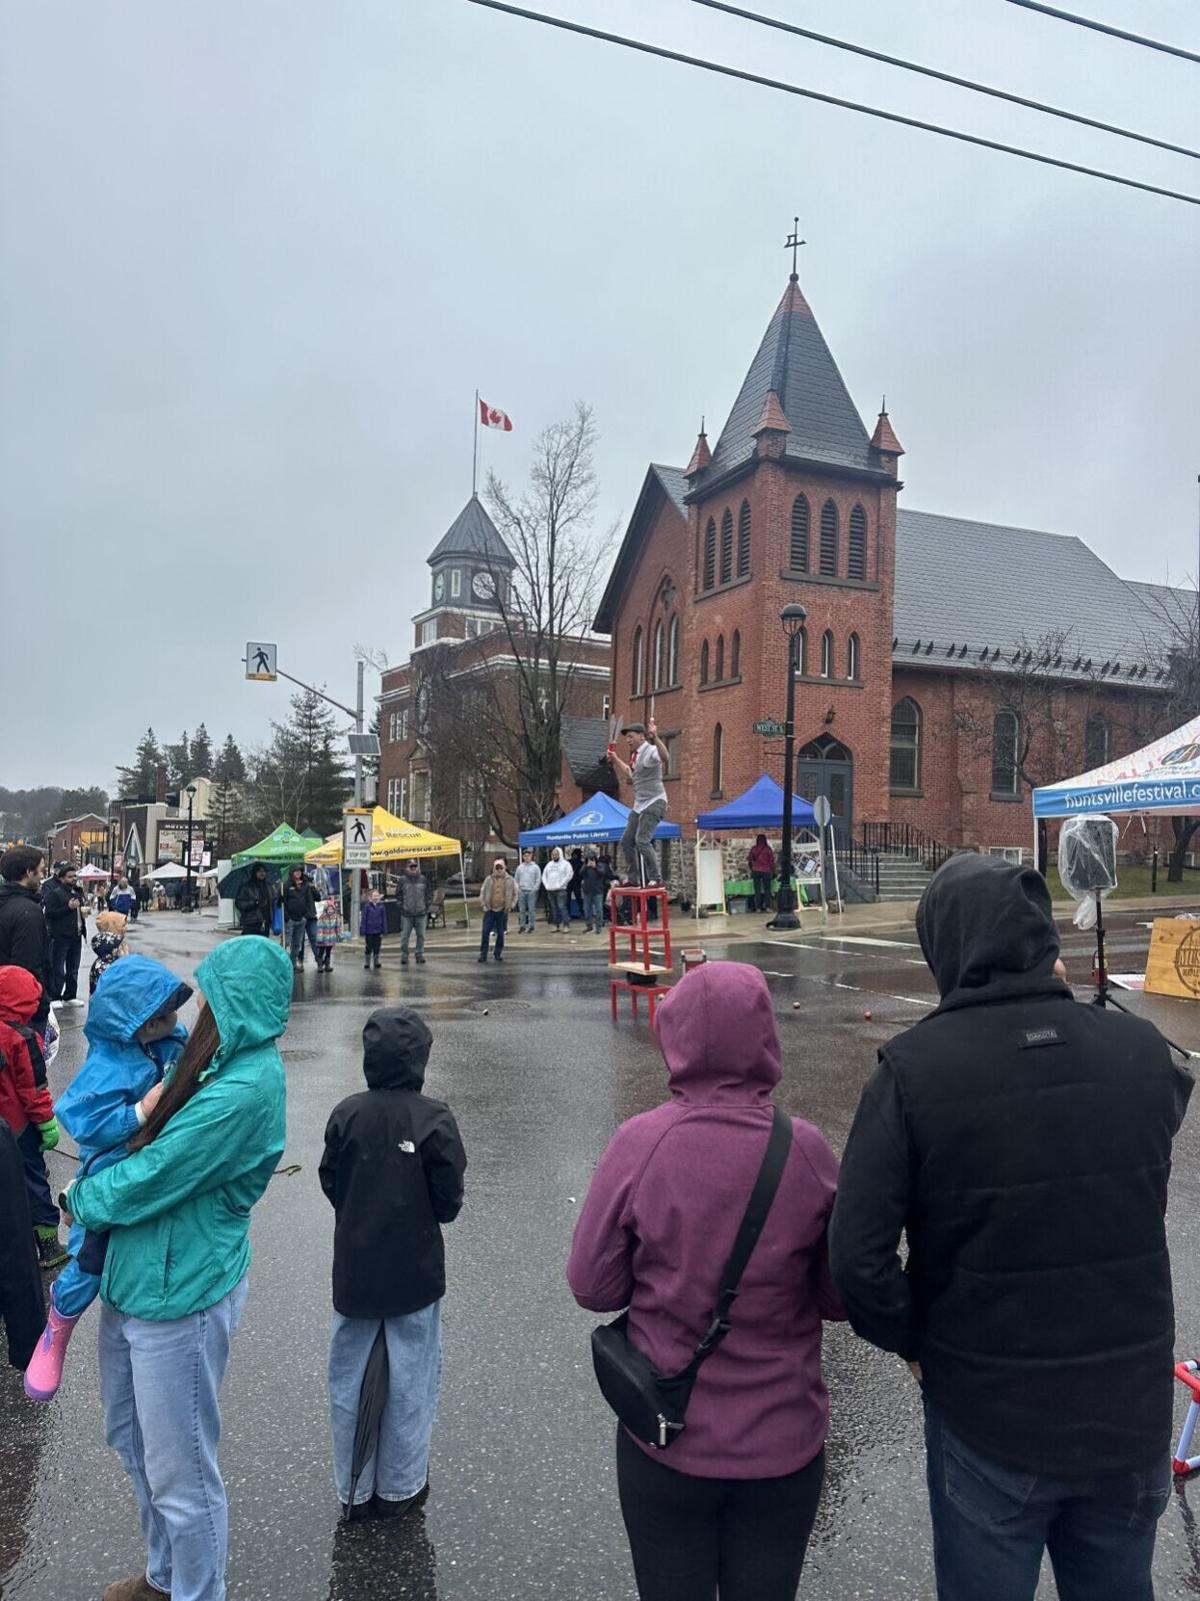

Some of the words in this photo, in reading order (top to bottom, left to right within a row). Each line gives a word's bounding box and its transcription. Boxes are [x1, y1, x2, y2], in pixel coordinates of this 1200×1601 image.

[757, 723, 771, 732] WEST
[385, 830, 422, 839] Rescue
[590, 831, 609, 839] Library
[370, 844, 443, 857] ww.goldenrescue.ca
